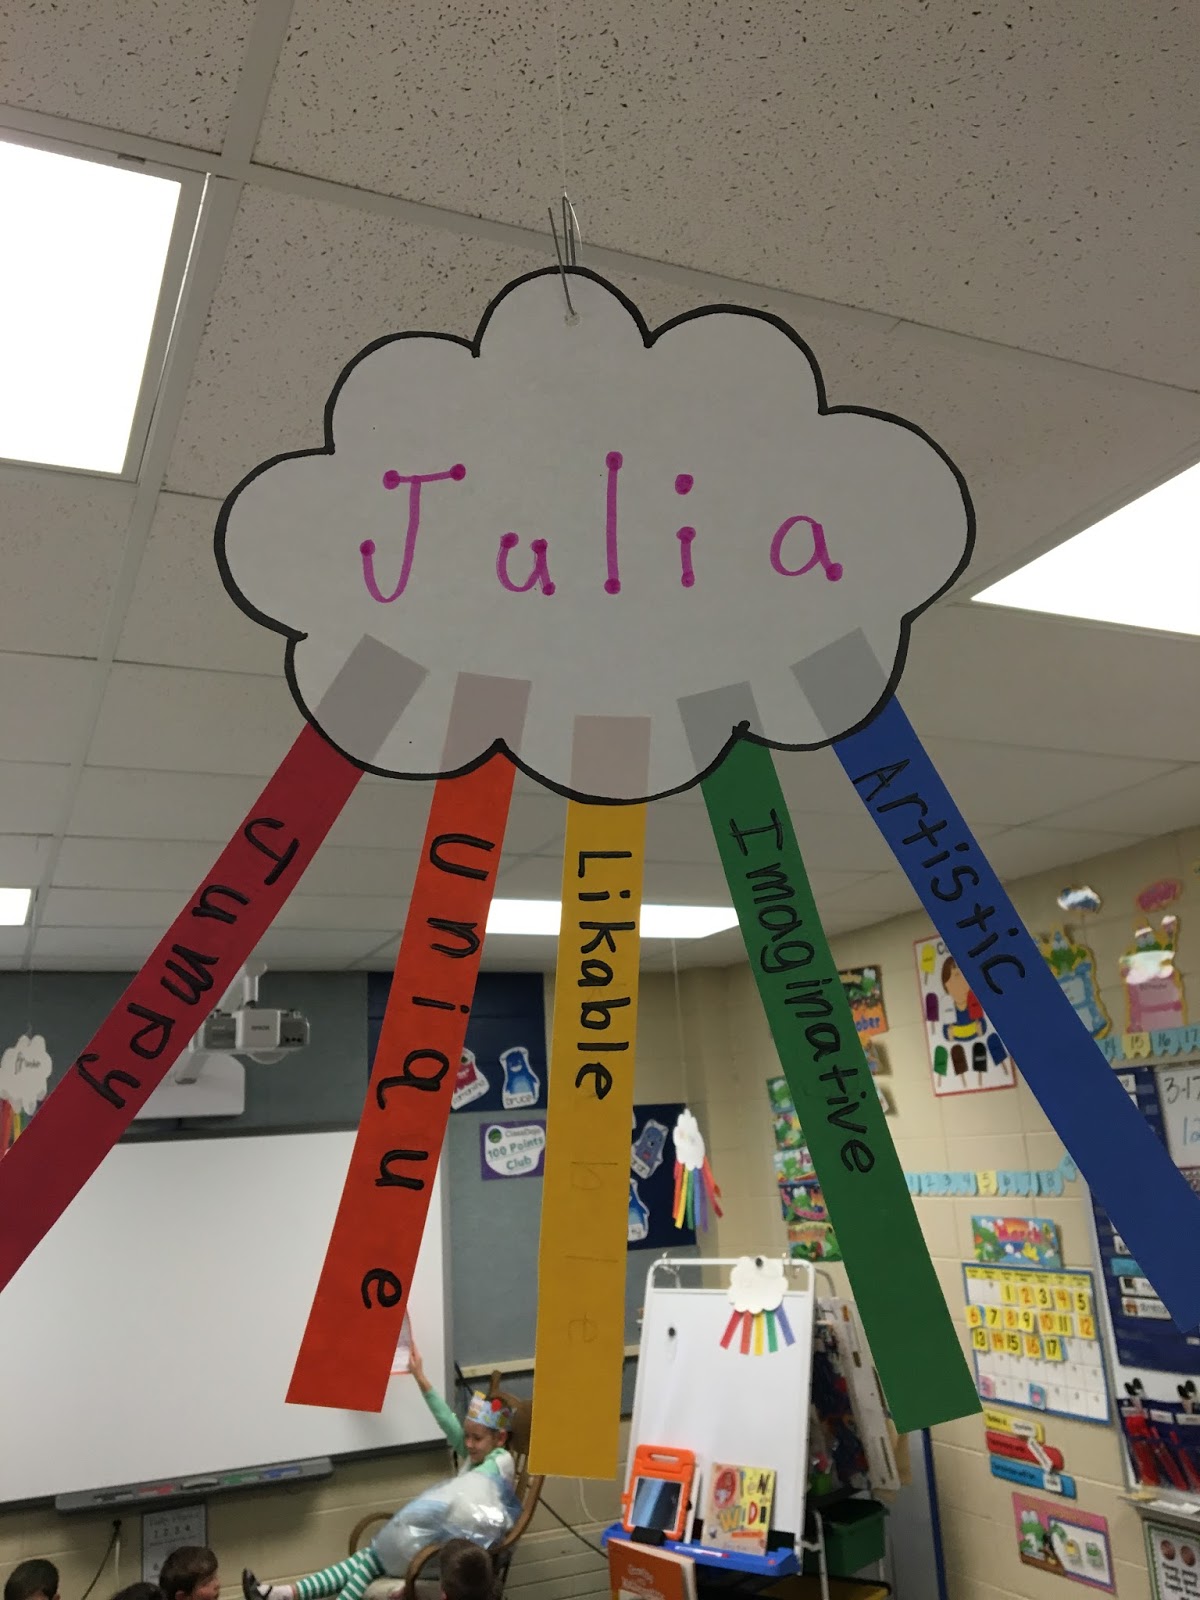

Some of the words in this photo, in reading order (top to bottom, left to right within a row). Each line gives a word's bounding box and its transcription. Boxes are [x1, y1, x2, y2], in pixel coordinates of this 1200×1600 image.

[360, 450, 843, 604] Julia
[853, 758, 1026, 996] Artistic
[574, 850, 636, 1101] Likable
[729, 809, 876, 1173] Imaginative
[855, 1014, 881, 1031] ober
[1130, 1036, 1145, 1050] 15
[1185, 1029, 1198, 1044] 17
[361, 832, 496, 1309] Unique
[487, 1145, 508, 1159] 100
[509, 1136, 544, 1153] Points
[506, 1155, 532, 1171] Club
[982, 1172, 991, 1188] 5
[1005, 1285, 1010, 1300] 1
[1021, 1287, 1031, 1304] 2
[1039, 1287, 1048, 1305] 3
[1057, 1288, 1067, 1306] 4
[1077, 1292, 1087, 1311] 5
[969, 1308, 979, 1324] 6
[990, 1308, 998, 1324] 7
[1006, 1310, 1016, 1327] 8
[1023, 1311, 1031, 1327] 9
[1040, 1313, 1054, 1331] 10
[1058, 1315, 1068, 1332] 11
[1079, 1318, 1092, 1335] 12
[975, 1331, 986, 1347] 13
[991, 1333, 1004, 1349] 14
[1006, 1333, 1019, 1351] 15
[1026, 1336, 1039, 1354] 16
[1046, 1338, 1057, 1356] 17
